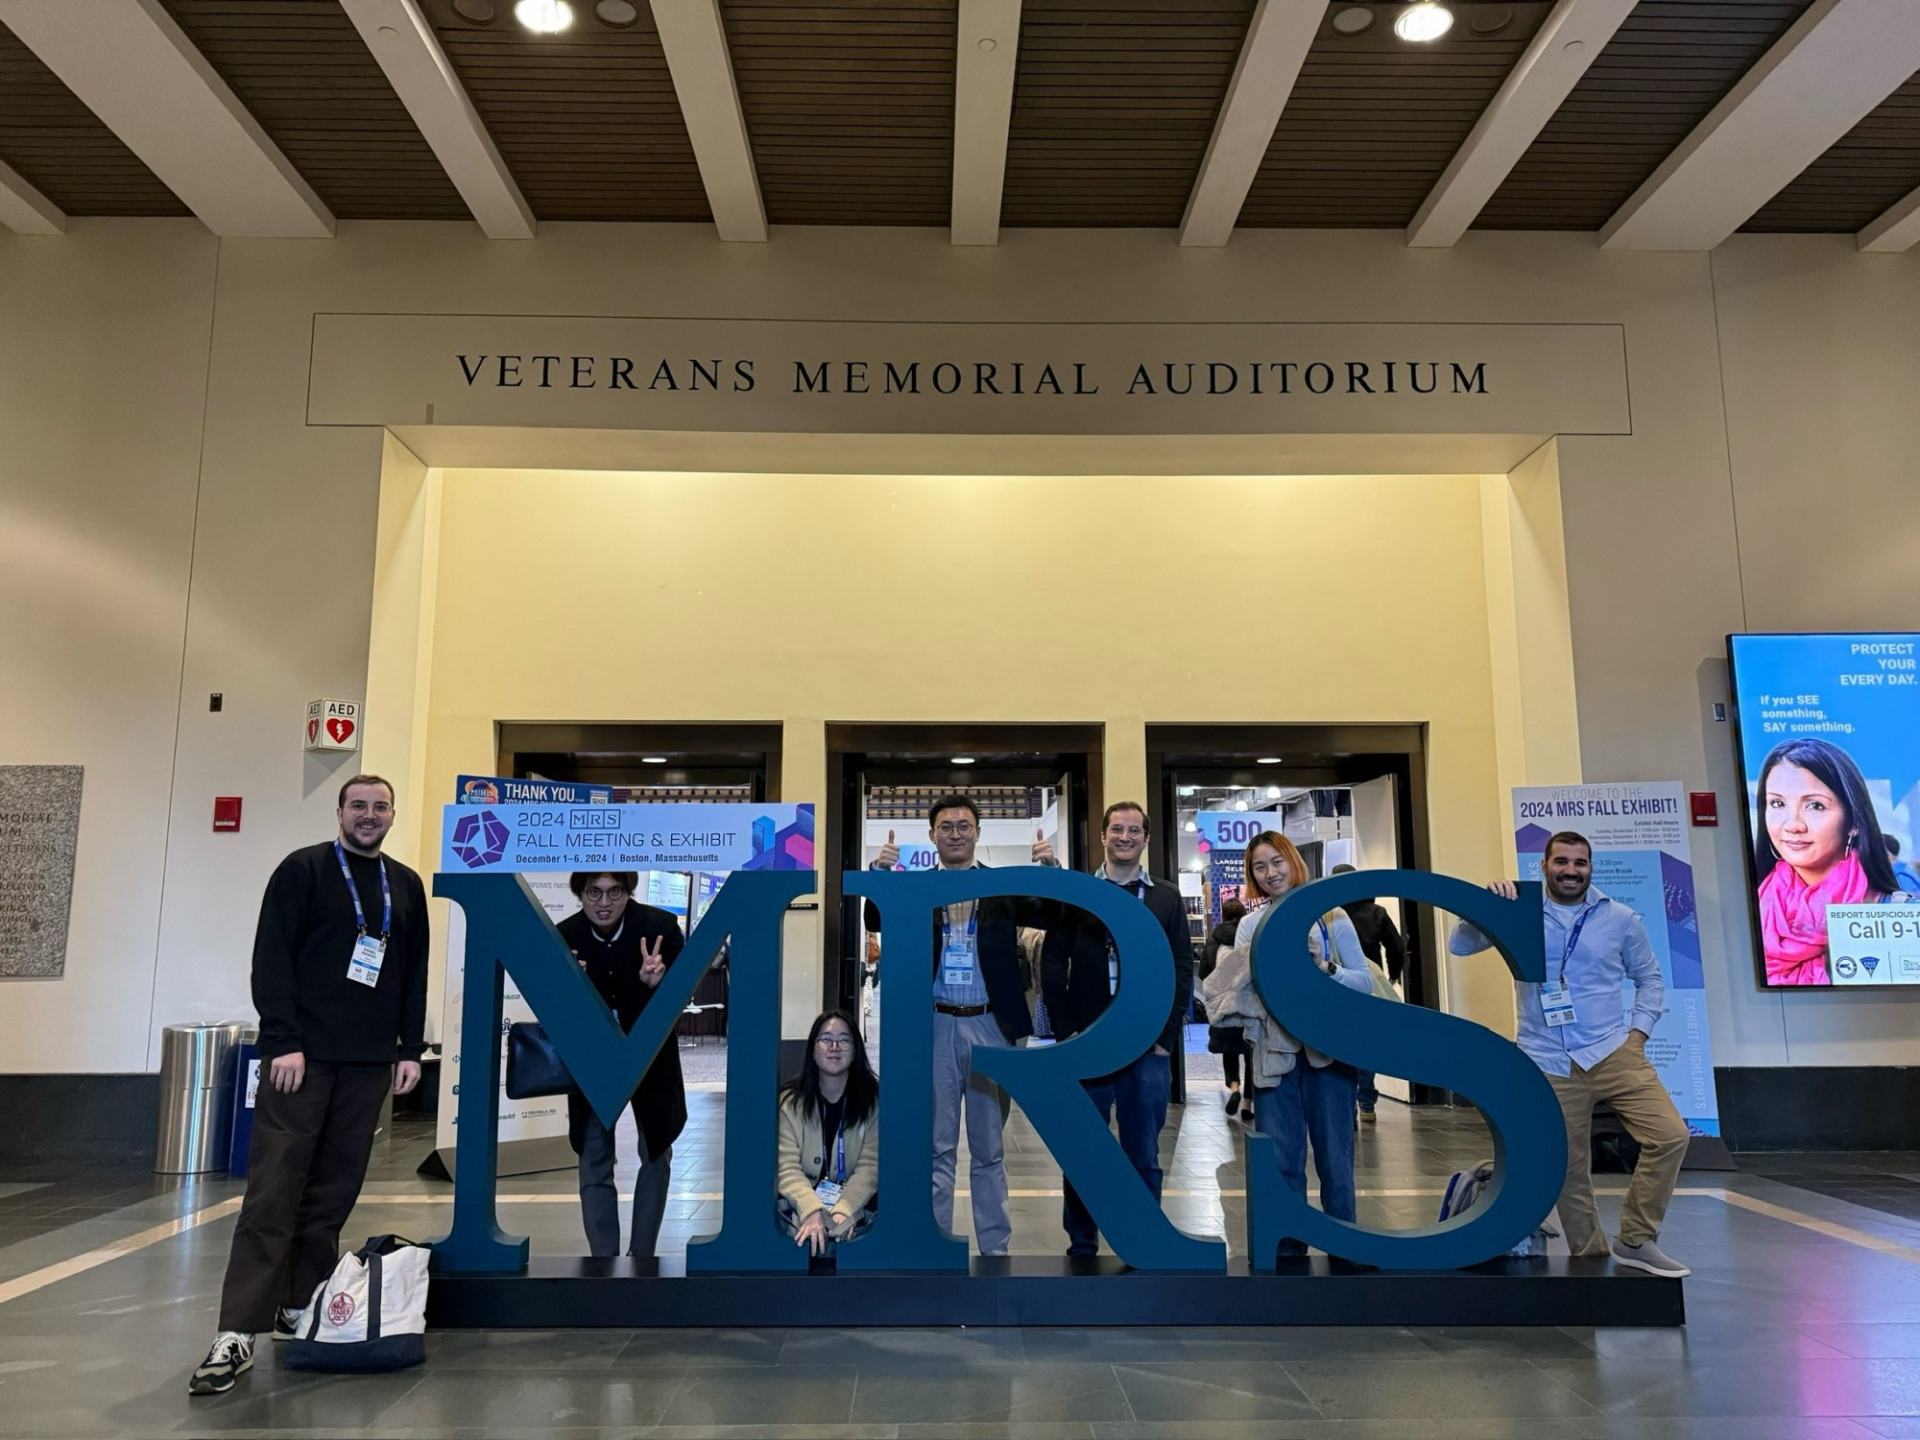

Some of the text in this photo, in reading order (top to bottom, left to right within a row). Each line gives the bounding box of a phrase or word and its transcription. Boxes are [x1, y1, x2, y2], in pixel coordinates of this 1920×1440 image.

[456, 354, 1490, 395] VETERANS MEMORIAL AUDITORIUM
[1851, 643, 1915, 655] PROTECT
[1878, 658, 1916, 670] YOUR
[1840, 674, 1918, 686] EVERY DAY.
[1760, 695, 1819, 707] If you SEE
[310, 703, 320, 716] AED
[329, 703, 355, 715] AED
[1761, 708, 1827, 720] something,
[1763, 721, 1856, 734] SAY something.
[504, 783, 548, 800] THANK
[1551, 787, 1643, 801] WELCOME TO THE
[1520, 798, 1677, 818] 2024 MRS FALL EXHIBIT!
[518, 812, 618, 828] 2024 MRS
[1217, 820, 1262, 843] 500
[517, 832, 736, 848] FALL MEETING & EXHIBIT
[516, 854, 560, 863] December
[585, 854, 607, 863] 2024
[620, 853, 652, 863] Boston,
[655, 853, 719, 863] Massachusetts
[1830, 911, 1864, 919] REPORT
[1848, 920, 1920, 939] Call 9-1
[430, 867, 1568, 1274] MRS
